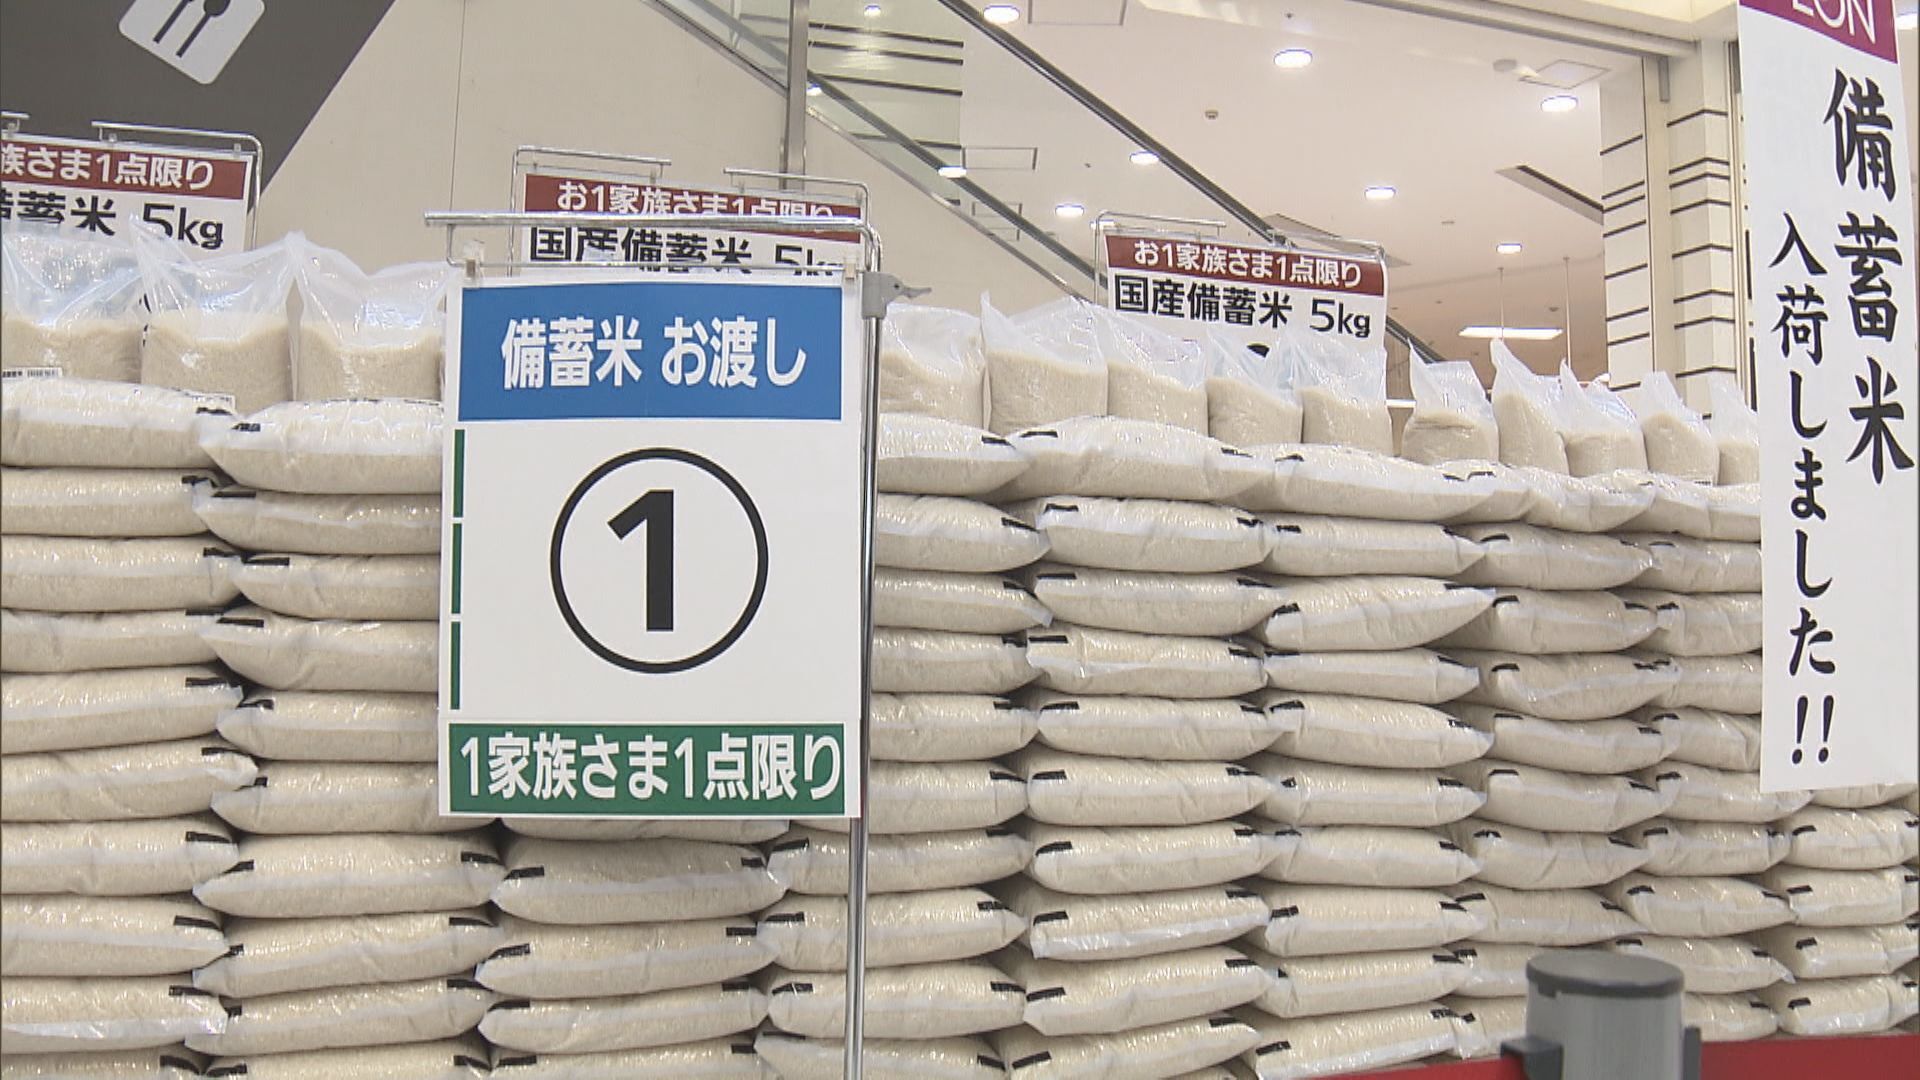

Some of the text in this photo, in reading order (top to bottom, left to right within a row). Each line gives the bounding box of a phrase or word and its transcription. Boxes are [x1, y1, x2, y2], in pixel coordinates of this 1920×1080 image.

[143, 203, 224, 249] 5kg
[530, 227, 752, 274] 国産備蓄米
[1134, 240, 1362, 288] お1家族さま1点限り
[1823, 67, 1915, 484] 備蓄米
[1114, 273, 1371, 339] 国産備蓄米 5kg
[501, 315, 807, 391] 備蓄米 お渡し
[1768, 211, 1836, 764] 入荷しました!!
[460, 731, 841, 800] 1家族さま1点限り
